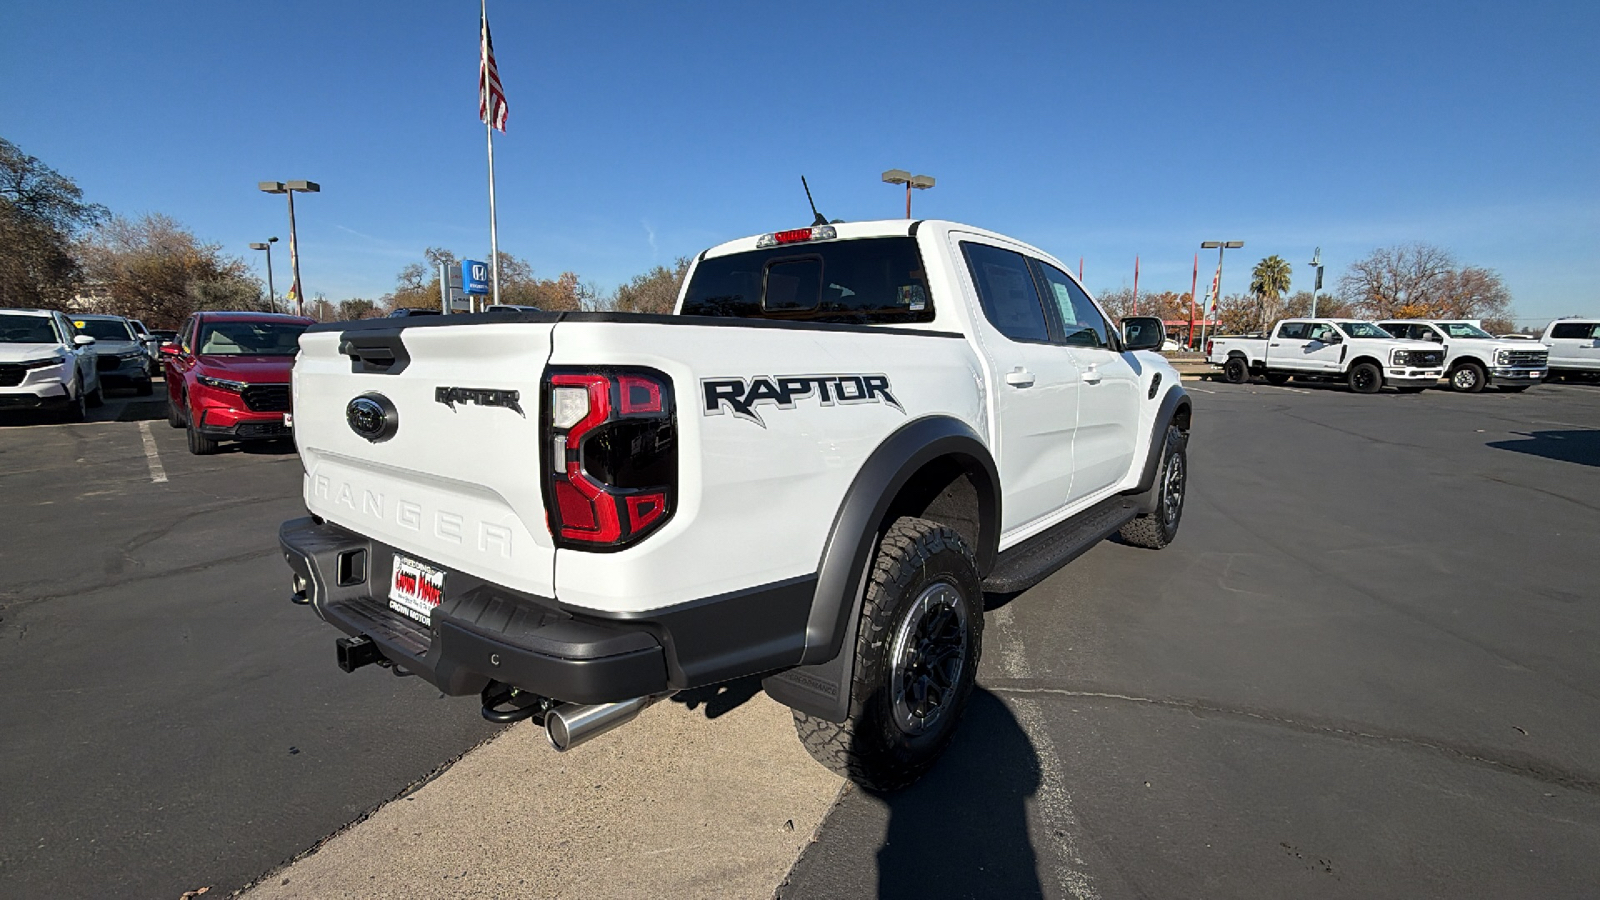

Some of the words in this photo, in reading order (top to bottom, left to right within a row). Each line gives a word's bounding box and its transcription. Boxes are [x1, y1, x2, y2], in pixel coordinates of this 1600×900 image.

[435, 386, 527, 419] RAPTOR
[700, 372, 907, 430] RAPTOR
[314, 474, 512, 559] RANGER
[389, 600, 410, 616] CROWN
[409, 608, 431, 627] MOTOR
